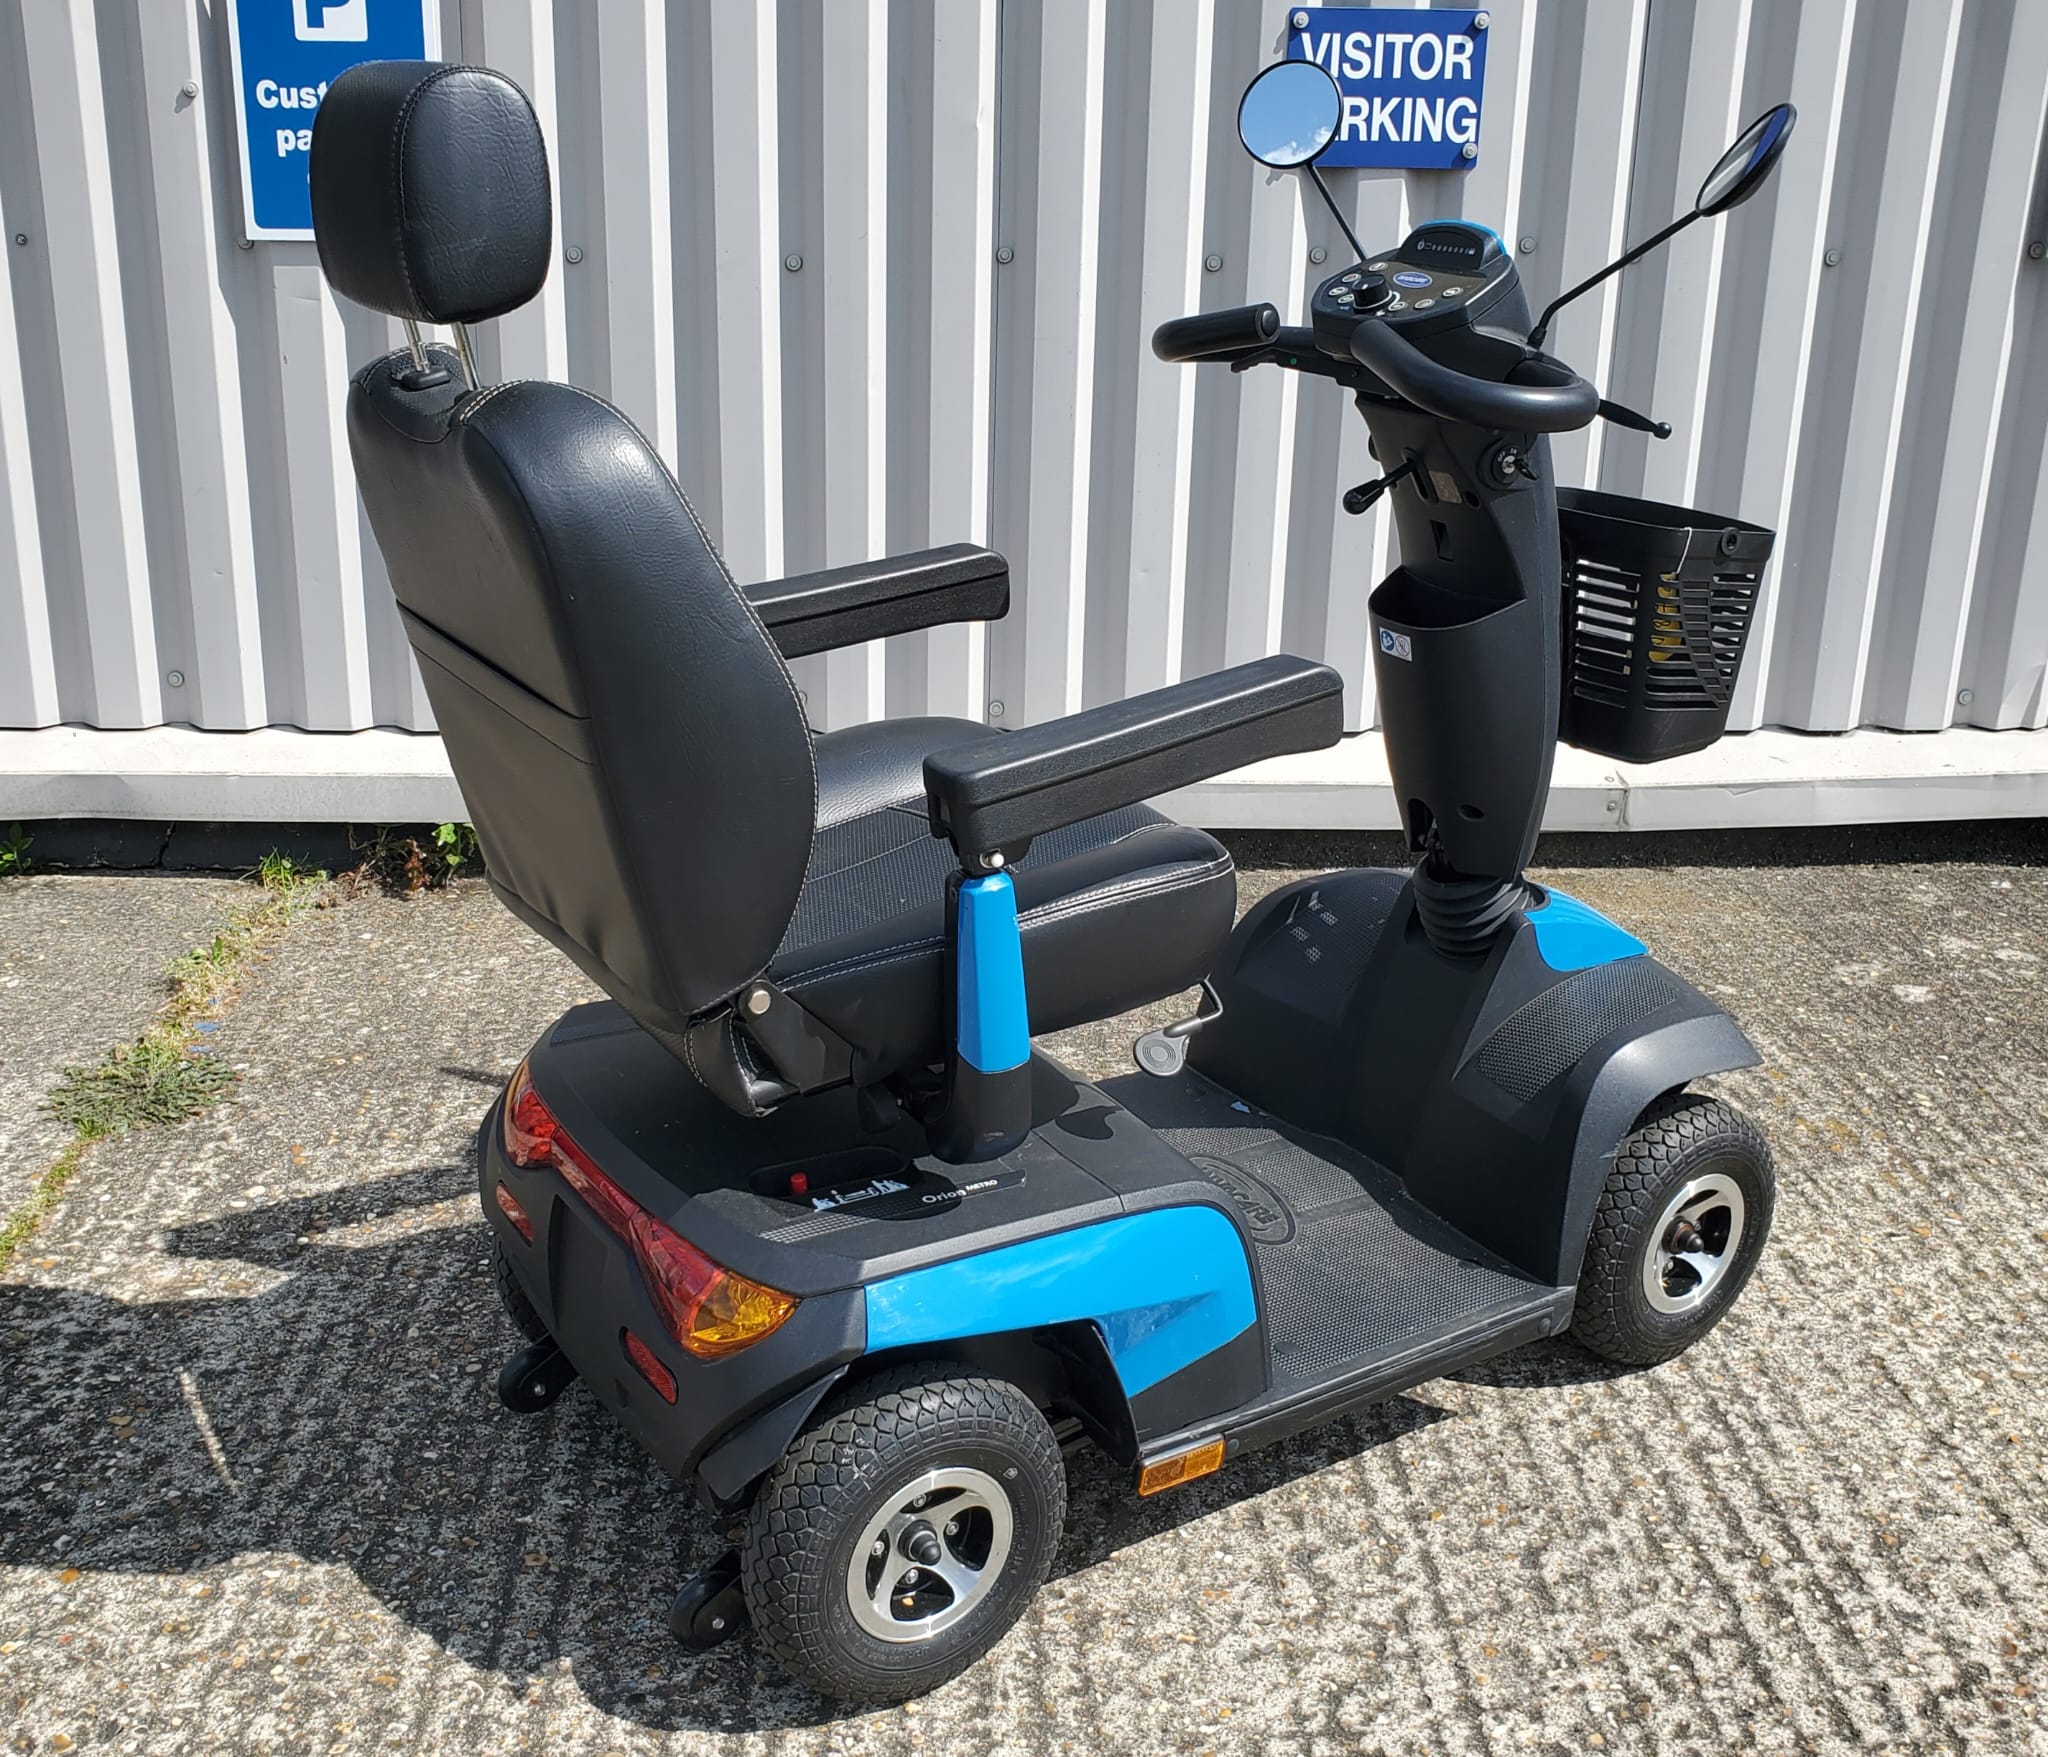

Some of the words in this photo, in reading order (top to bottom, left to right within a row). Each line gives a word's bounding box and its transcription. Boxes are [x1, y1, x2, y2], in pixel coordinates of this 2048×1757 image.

[1301, 31, 1474, 80] VISITOR
[1335, 96, 1477, 143] RKING
[922, 1189, 967, 1203] Orion
[965, 1179, 998, 1191] METRO
